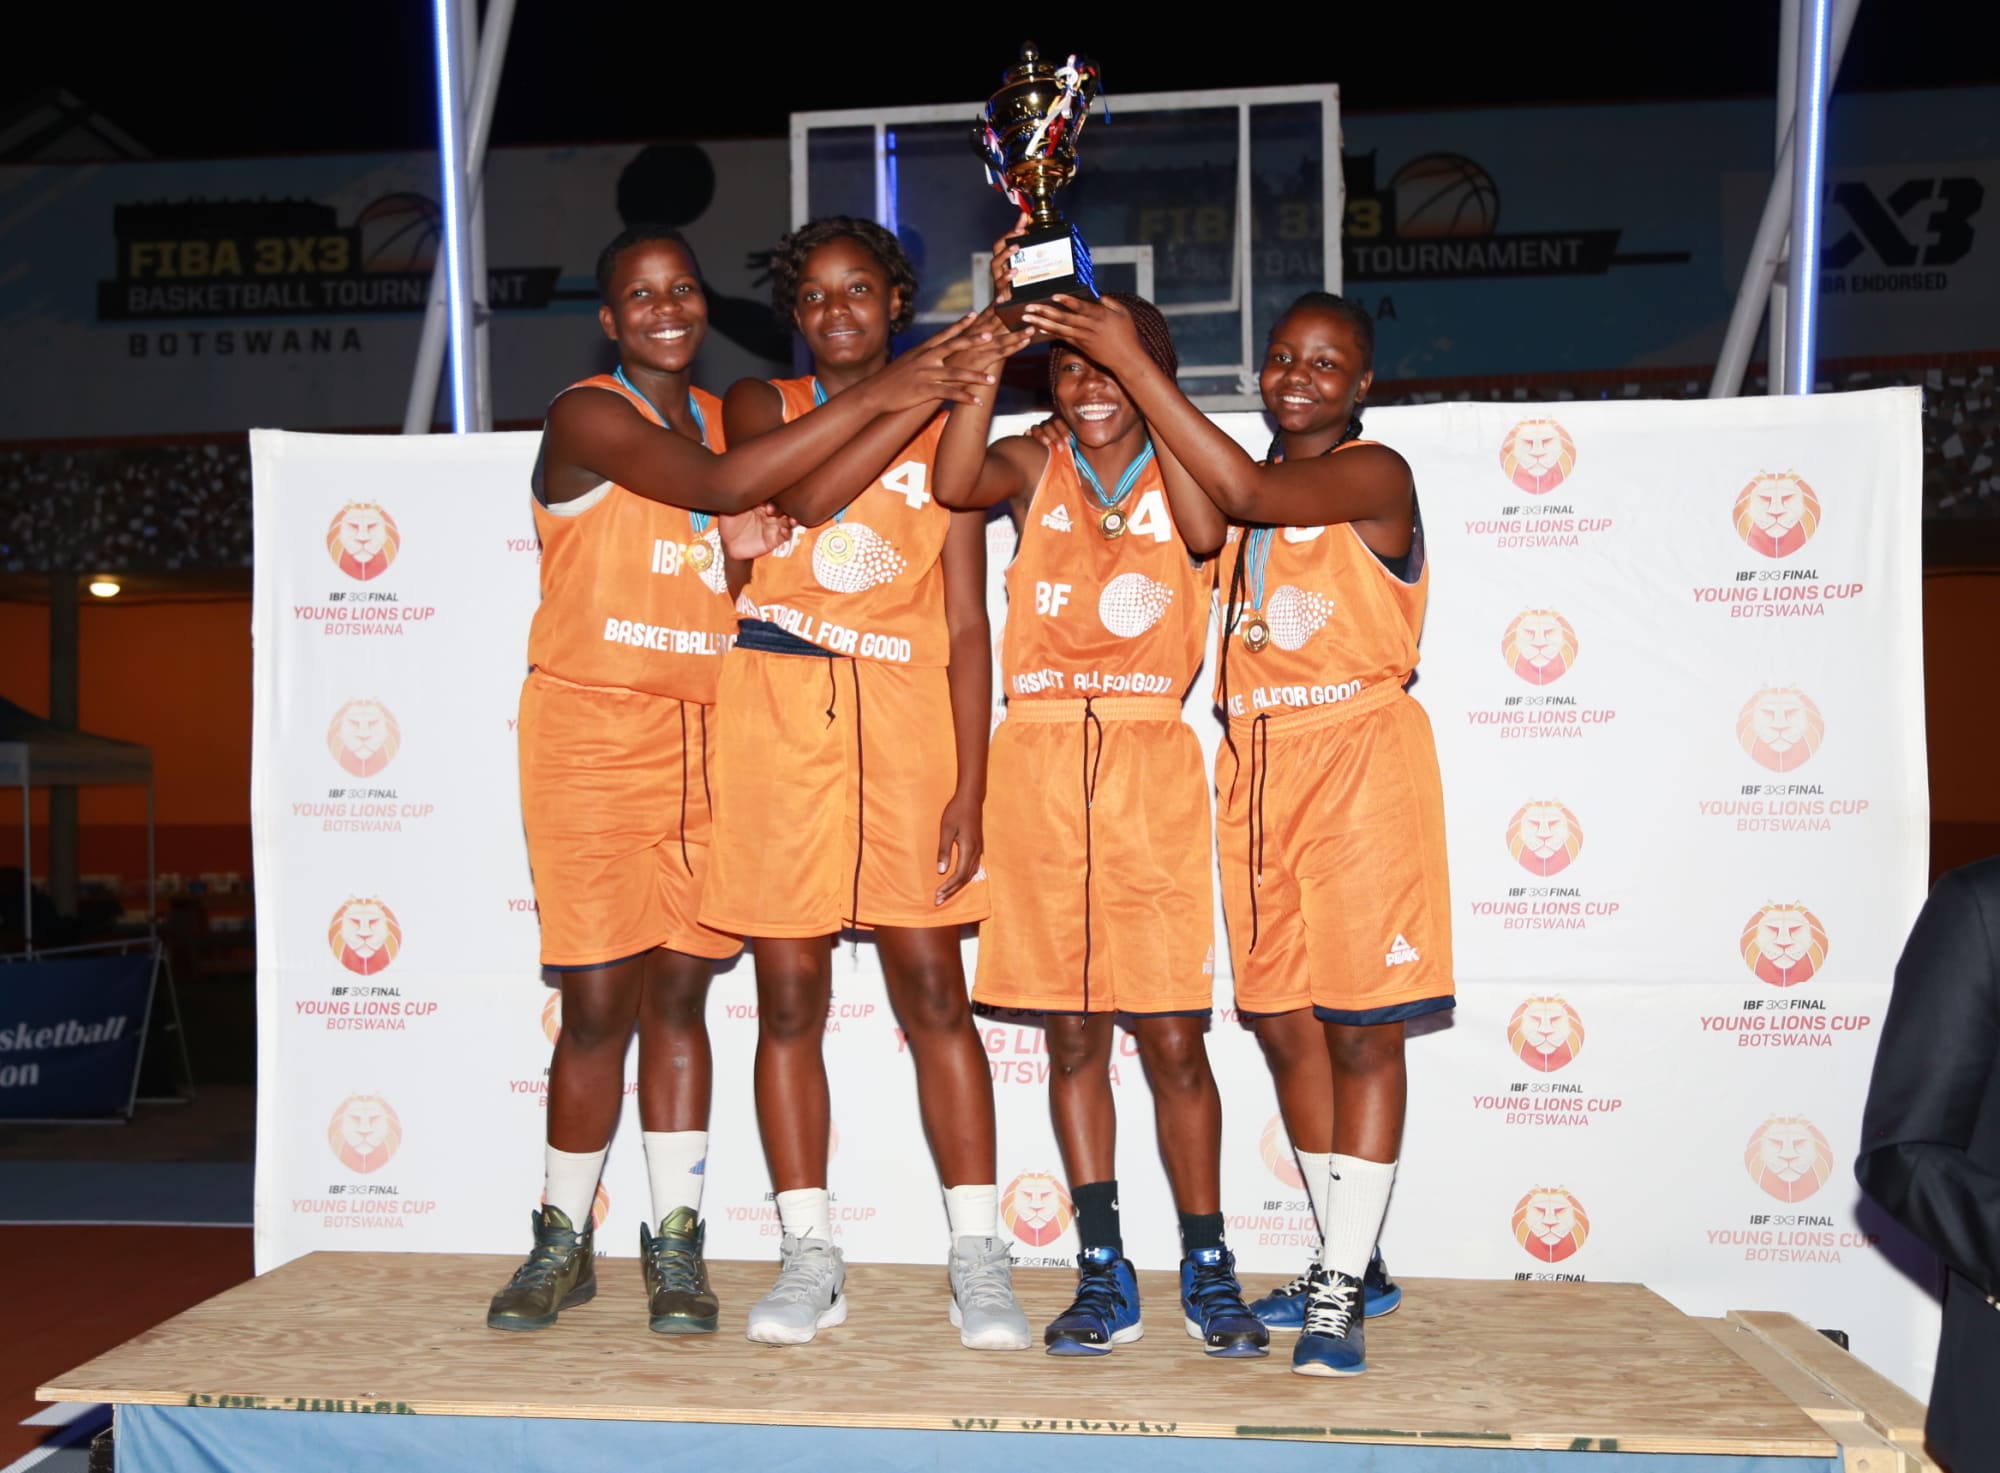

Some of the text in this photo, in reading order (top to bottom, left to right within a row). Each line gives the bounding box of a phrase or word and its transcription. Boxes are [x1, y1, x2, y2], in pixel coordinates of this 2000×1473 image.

[1278, 199, 1383, 240] 33
[128, 236, 351, 278] FIBA 3X3
[1353, 239, 1584, 274] TOURNAMENT
[1853, 272, 1947, 293] ENDORSED
[128, 274, 527, 314] BASKETBALL TOURNNT
[130, 328, 362, 358] BOTSWANA
[881, 460, 931, 511] 4
[1127, 489, 1173, 543] 4
[1502, 505, 1520, 515] IBF
[1543, 505, 1575, 515] FINAL
[1465, 518, 1612, 535] YOUNG LIONS CUP
[506, 539, 537, 552] YOU
[1497, 535, 1579, 548] BOTSWANA
[652, 539, 687, 576] IBF
[1736, 569, 1757, 582] IBF
[1782, 569, 1819, 582] FINAL
[329, 592, 347, 601] IBF
[368, 592, 399, 601] FINAL
[1693, 583, 1863, 603] YOUNG LIONS CUP
[293, 606, 435, 621] YOUNG LIONS CUP
[1730, 603, 1825, 618] BOTSWANA
[324, 623, 404, 636] BOTSWANA
[816, 621, 859, 654] FOR
[860, 632, 912, 663] GOOD
[1505, 695, 1523, 706] IBF
[1546, 695, 1577, 706] FINAL
[1467, 709, 1615, 725] YOUNG LIONS CUP
[1500, 726, 1583, 739] BOTSWANA
[328, 789, 346, 799] IBF
[367, 789, 398, 799] FINAL
[1741, 784, 1762, 796] IBF
[1788, 784, 1824, 796] FINAL
[292, 803, 434, 818] YOUNG LIONS CUP
[1698, 799, 1869, 817] YOUNG LIONS CUP
[322, 820, 402, 833] BOTSWANA
[1736, 817, 1831, 832] BOTSWANA
[1508, 887, 1527, 897] IBF
[1549, 887, 1581, 897] FINAL
[1471, 901, 1619, 917] YOUNG LIONS CUP
[1503, 917, 1586, 930] BOTSWANA
[331, 986, 349, 997] IBF
[371, 986, 401, 997] FINAL
[295, 1000, 437, 1016] YOUNG LIONS CUP
[726, 1005, 759, 1018] YOU
[840, 1004, 875, 1018] CUP
[1743, 999, 1764, 1011] IBF
[1790, 999, 1826, 1011] FINAL
[326, 1018, 406, 1031] BOTSWANA
[1700, 1015, 1871, 1032] YOUNG LIONS CUP
[1738, 1033, 1832, 1048] BOTSWANA
[510, 1080, 548, 1094] YOUN
[1510, 1083, 1529, 1093] IBF
[1552, 1083, 1584, 1093] FINAL
[1473, 1096, 1622, 1113] YOUNG LIONS CUP
[1506, 1112, 1589, 1126] BOTSWANA
[329, 1184, 347, 1195] IBF
[368, 1184, 399, 1195] FINAL
[291, 1199, 436, 1215] YOUNG LIONS CUP
[1263, 1201, 1283, 1210] IBF
[726, 1207, 778, 1221] YOUN
[841, 1207, 876, 1221] CUP
[1750, 1214, 1771, 1227] IBF
[1797, 1214, 1834, 1227] FINAL
[323, 1215, 404, 1229] BOTSWANA
[1224, 1215, 1317, 1231] YOUNG LIO
[1259, 1233, 1320, 1246] BOTSW
[1707, 1230, 1881, 1249] YOUNG LIONS CUP
[1042, 1257, 1072, 1267] FINAL
[1744, 1248, 1841, 1264] BOTSWANA
[1515, 1272, 1533, 1280] IBF
